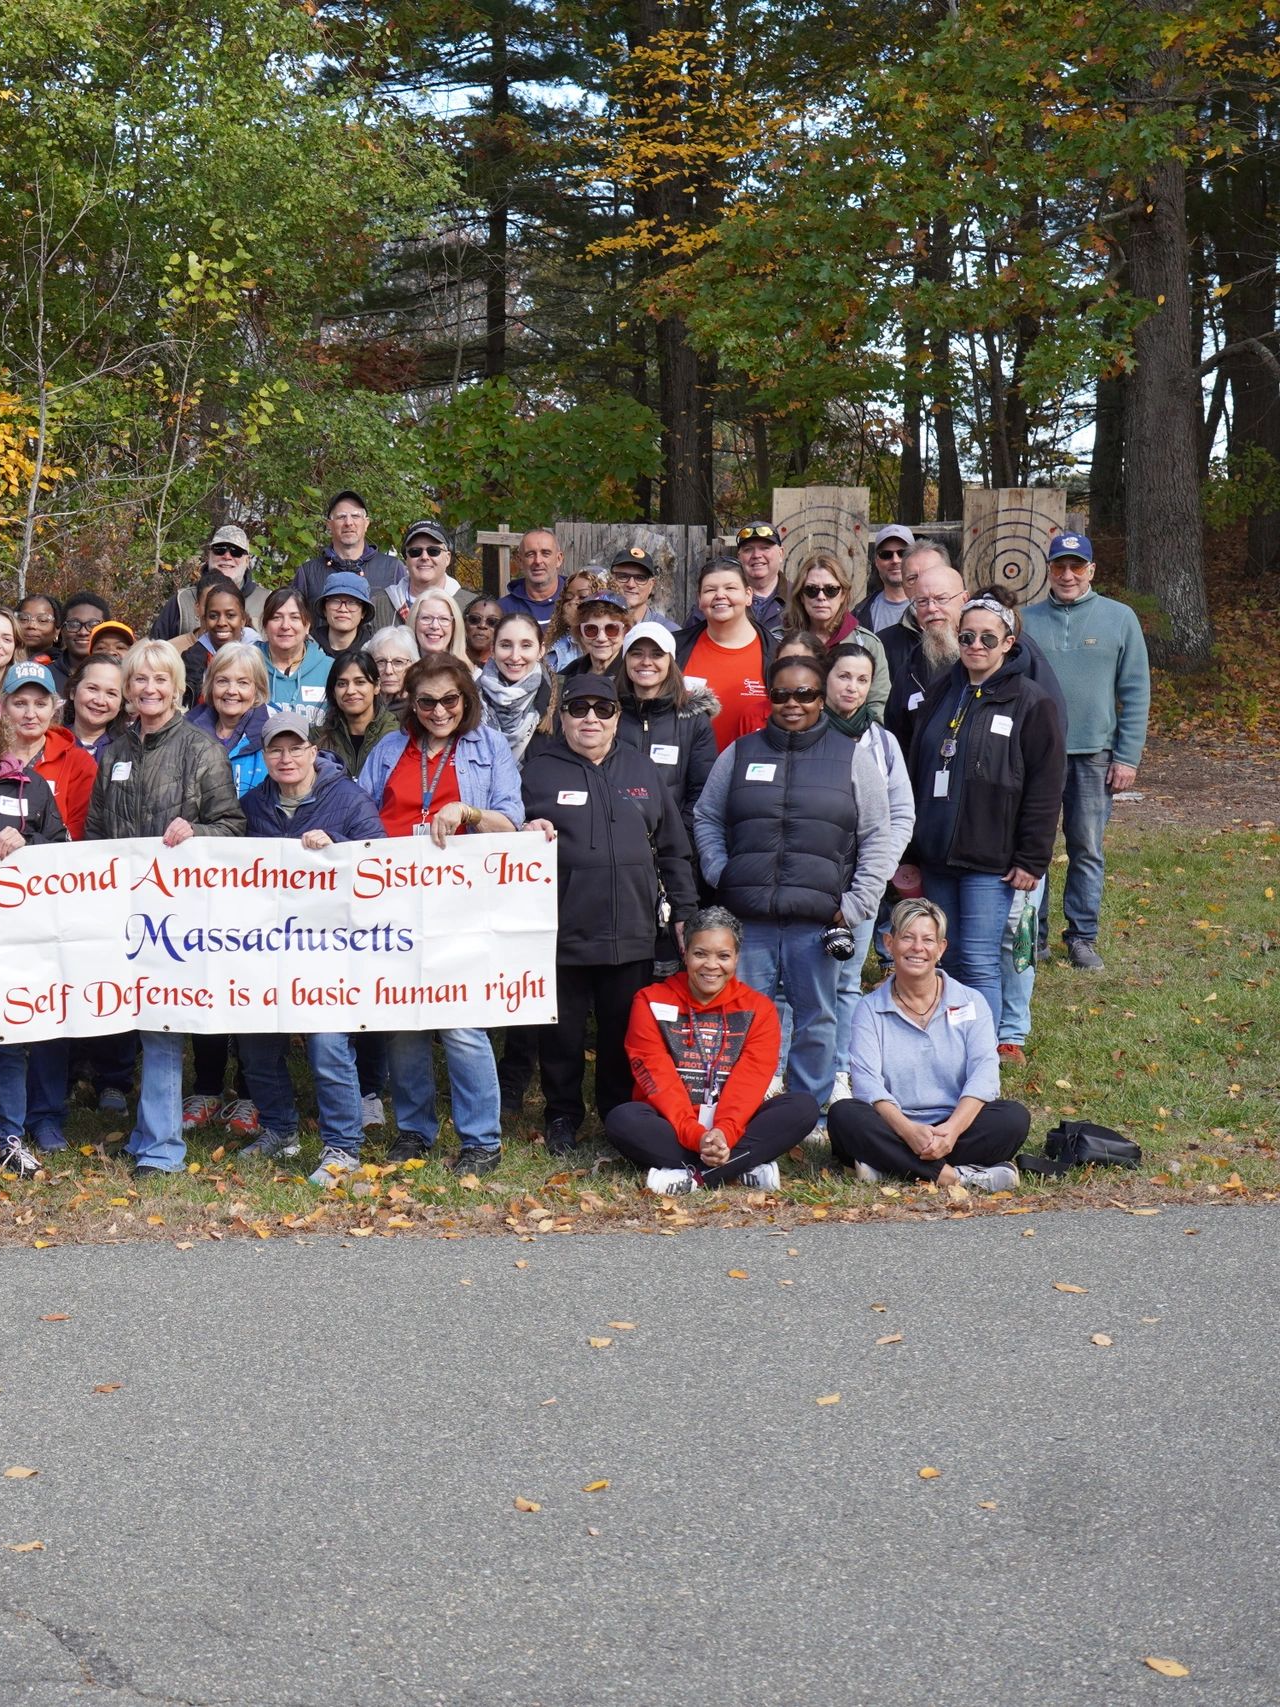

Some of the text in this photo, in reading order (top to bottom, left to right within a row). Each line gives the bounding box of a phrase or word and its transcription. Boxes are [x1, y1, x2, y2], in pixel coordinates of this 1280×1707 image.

[130, 856, 338, 898] Amendment
[353, 857, 473, 899] Sisters,
[484, 852, 552, 885] Inc.
[126, 913, 414, 962] Massachusetts
[3, 970, 547, 1025] Self Defense: is a basic human right
